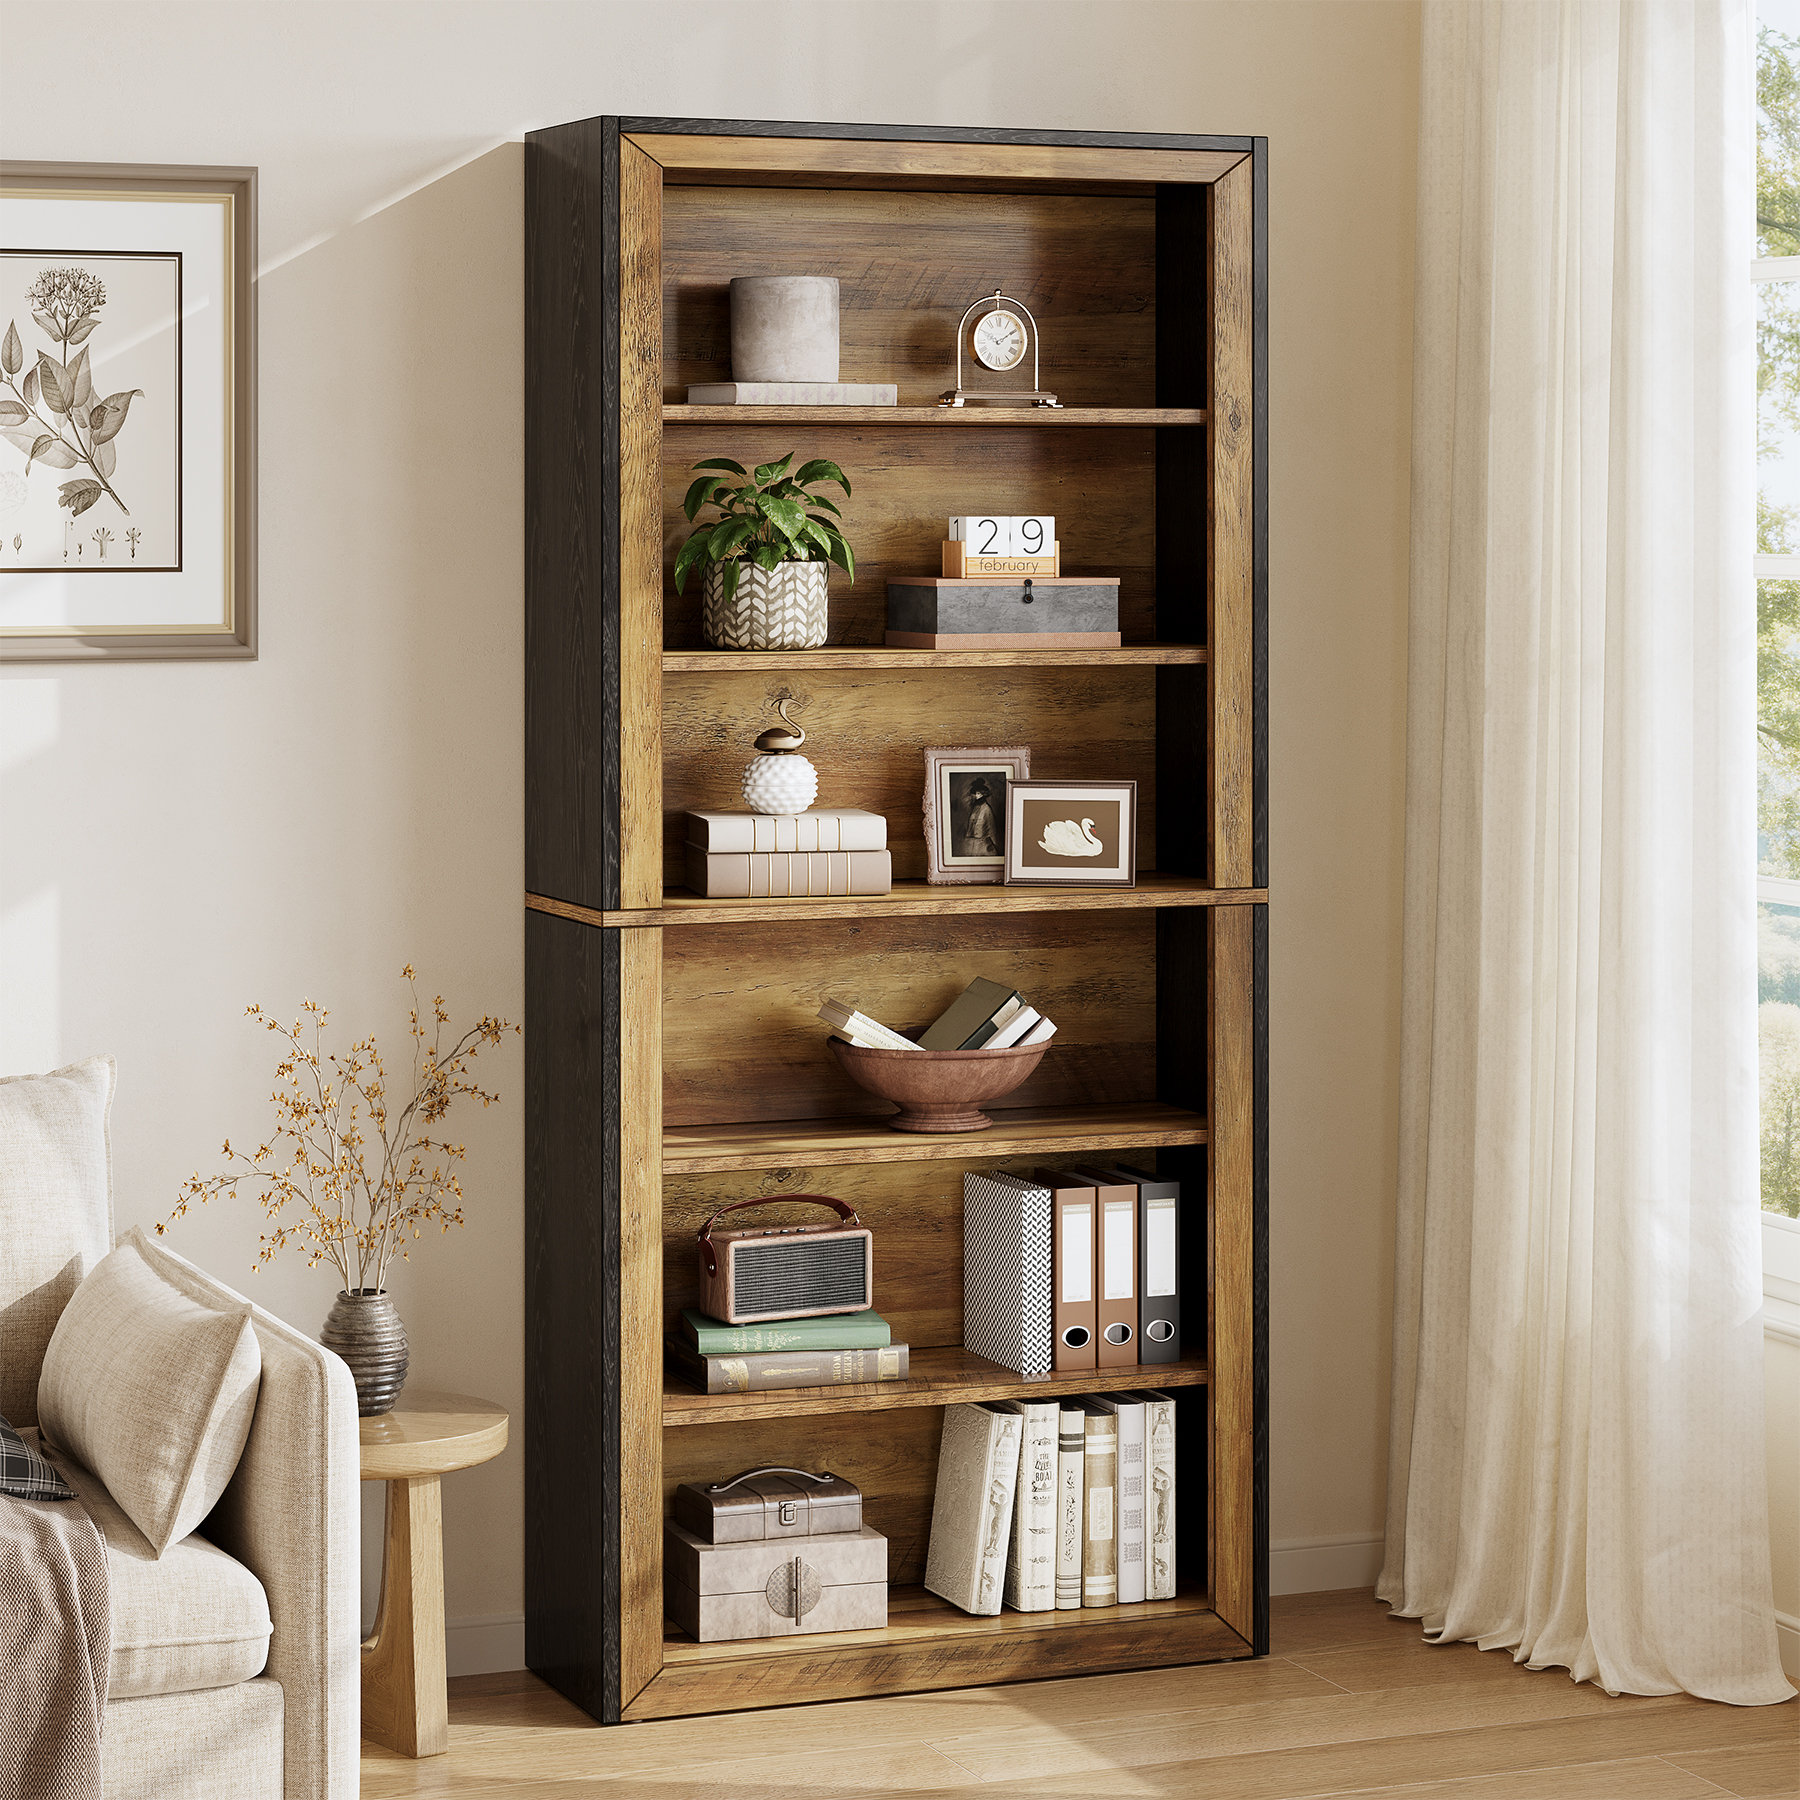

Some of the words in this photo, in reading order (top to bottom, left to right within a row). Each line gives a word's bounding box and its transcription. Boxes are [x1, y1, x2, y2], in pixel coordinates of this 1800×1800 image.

[979, 557, 1039, 574] february
[832, 1354, 841, 1381] WORK
[1035, 1471, 1052, 1482] BOAT
